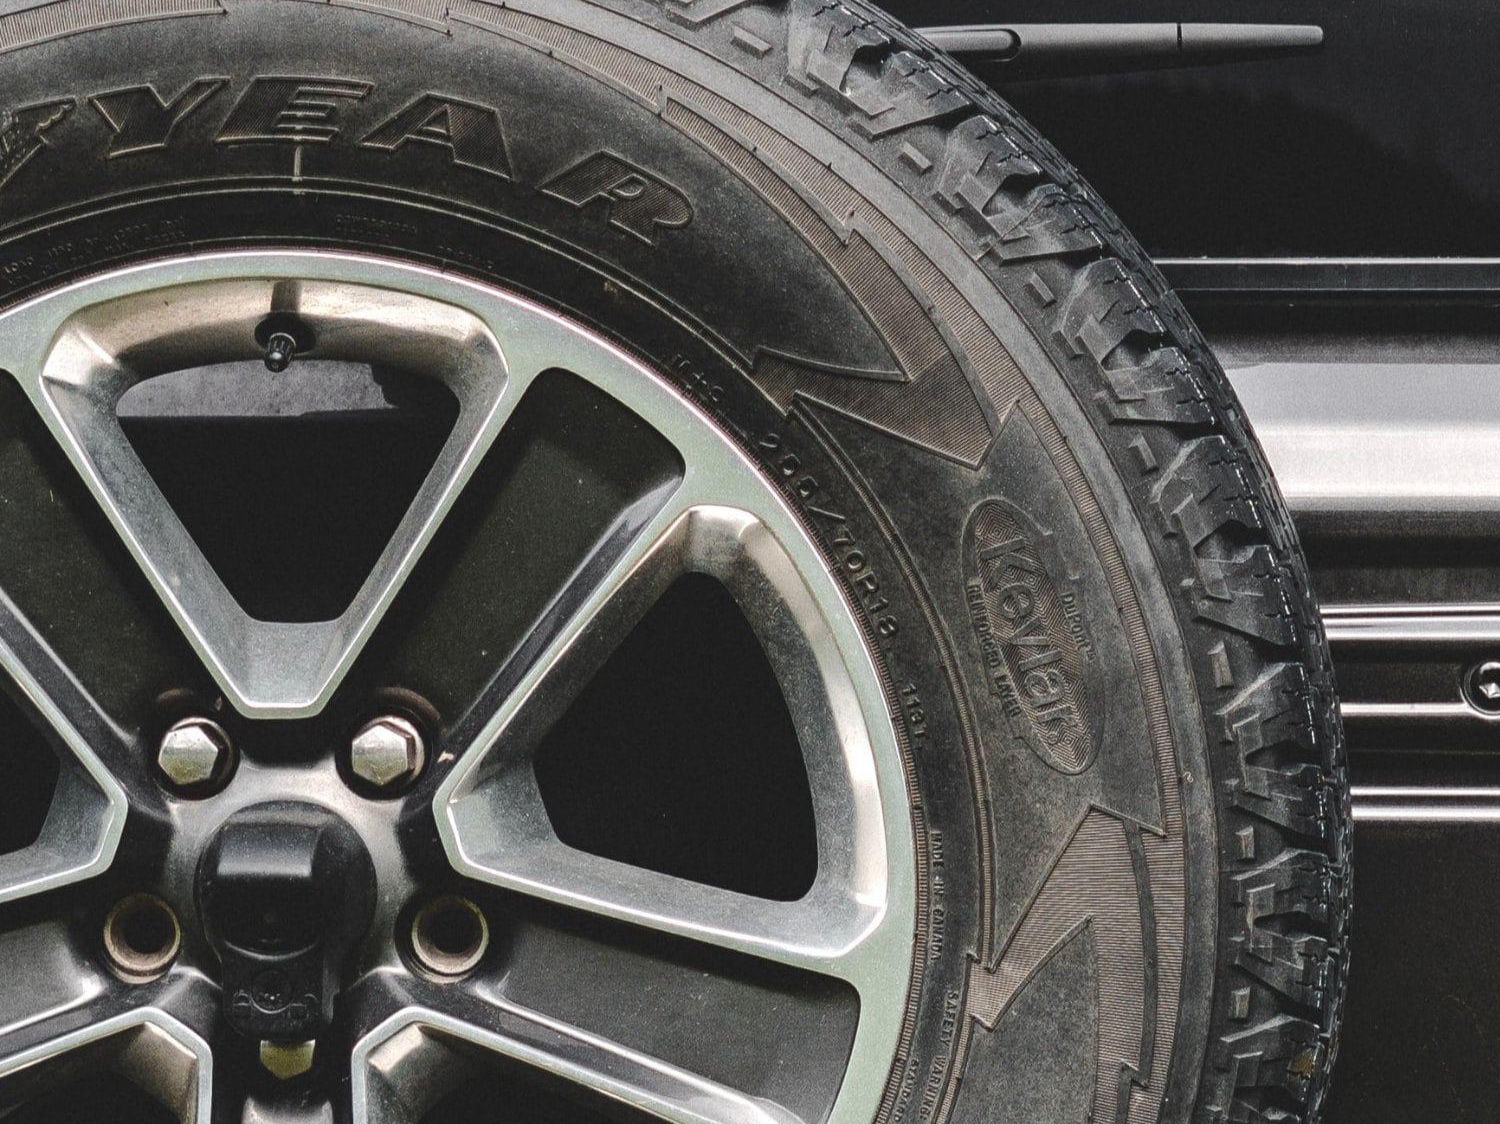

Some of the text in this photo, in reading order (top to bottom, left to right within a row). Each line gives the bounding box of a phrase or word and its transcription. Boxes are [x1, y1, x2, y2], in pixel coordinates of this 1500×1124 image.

[88, 75, 695, 247] YEAR
[757, 432, 900, 639] 255/70R18
[967, 584, 1001, 669] REINFORCED
[981, 536, 1079, 726] Kevlar
[930, 908, 945, 961] CANADA
[940, 989, 958, 1047] SAFETY
